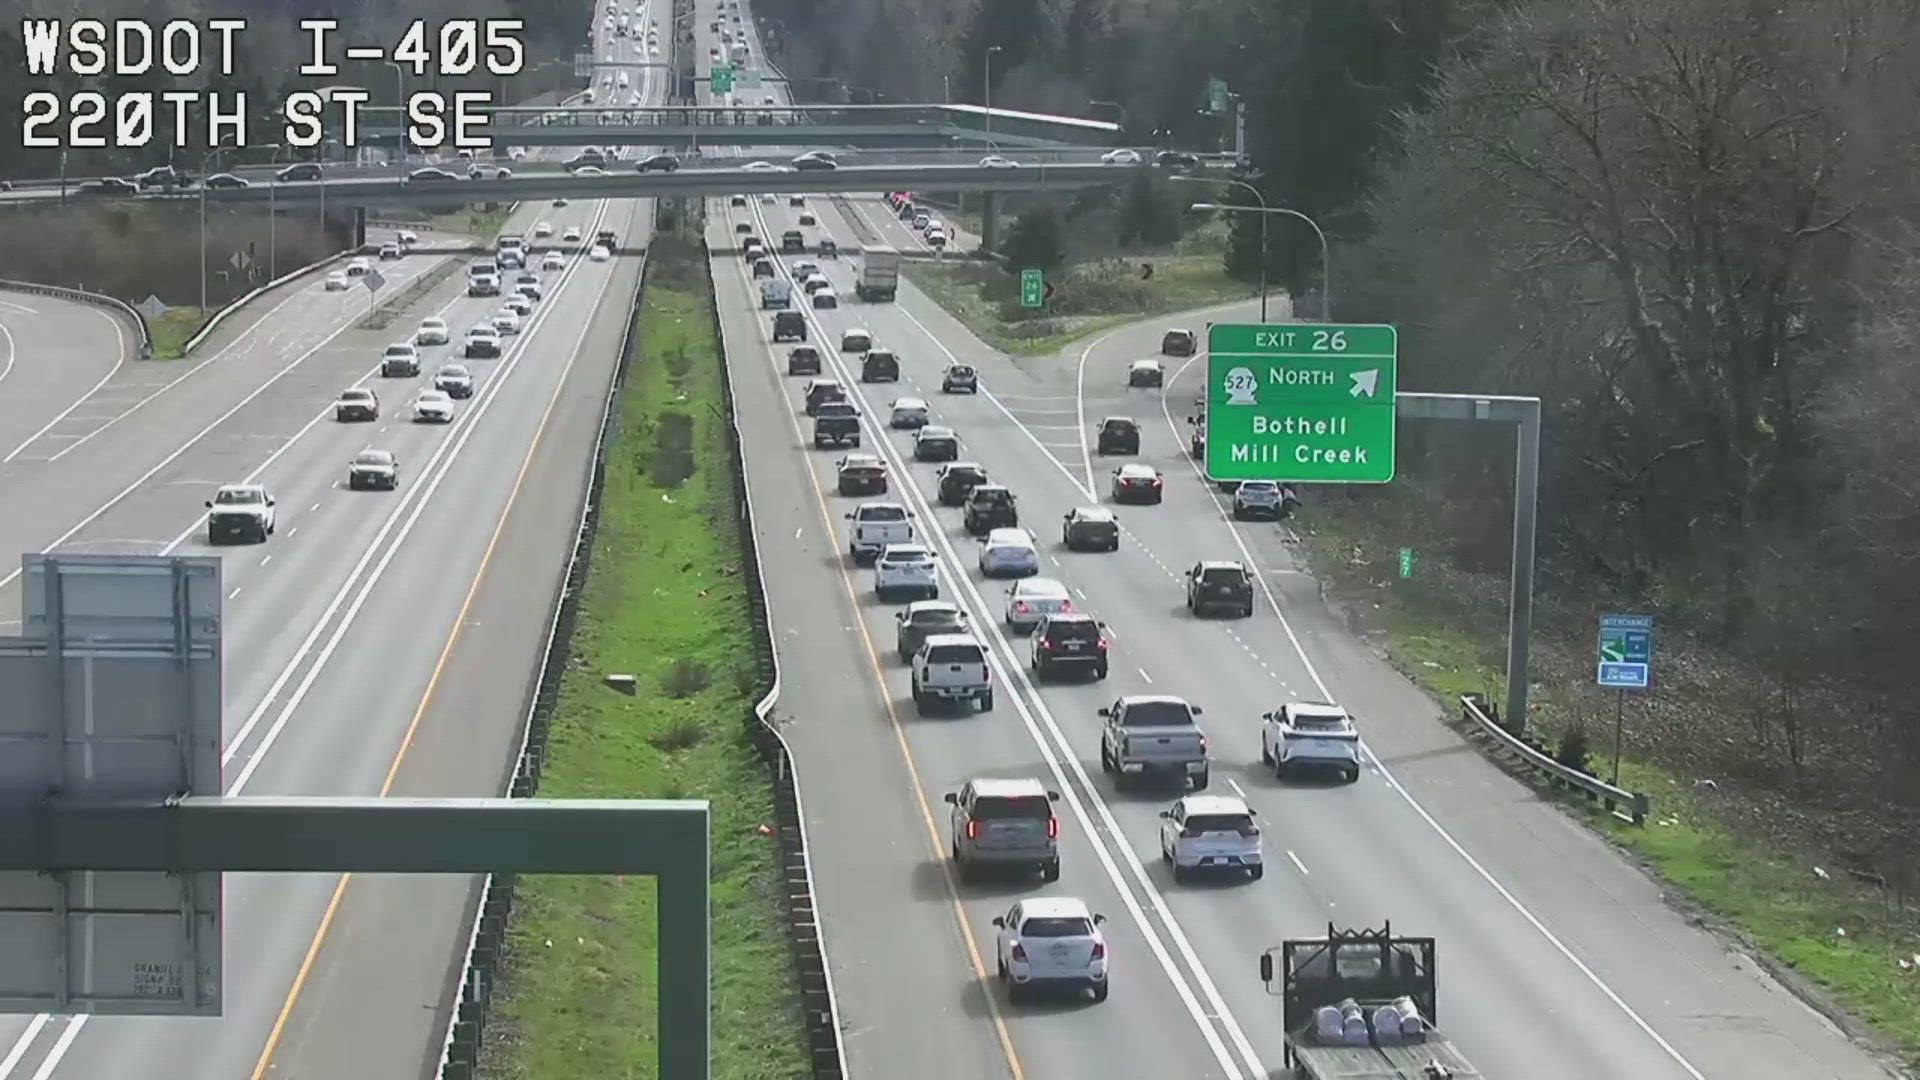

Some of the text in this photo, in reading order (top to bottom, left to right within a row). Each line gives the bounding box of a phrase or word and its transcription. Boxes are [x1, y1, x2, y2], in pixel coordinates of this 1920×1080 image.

[1256, 330, 1348, 351] EXIT 26
[1226, 367, 1335, 390] 527 NORTH
[1253, 415, 1347, 435] Bothell
[1231, 443, 1368, 464] Mill Creek
